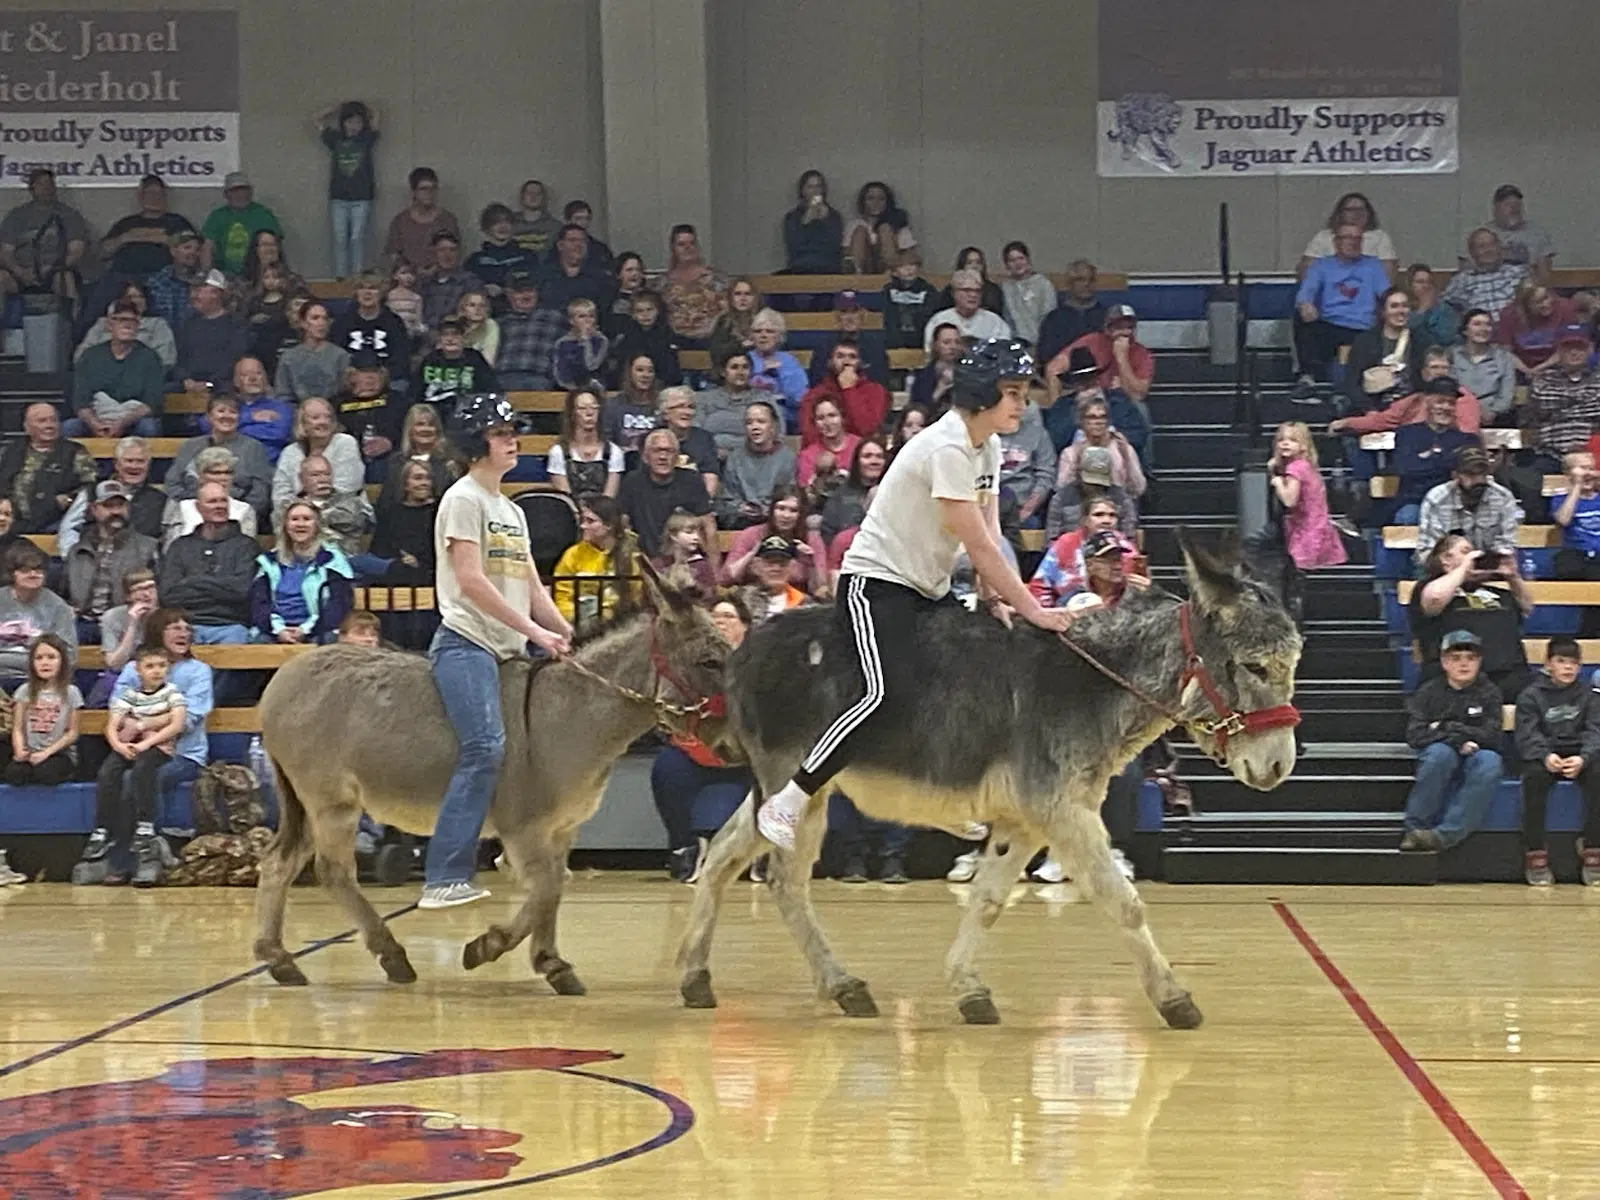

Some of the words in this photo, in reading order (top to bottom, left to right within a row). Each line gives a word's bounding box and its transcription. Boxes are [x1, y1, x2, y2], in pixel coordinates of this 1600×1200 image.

[26, 21, 67, 52] &
[72, 20, 181, 60] Janel
[0, 119, 95, 149] roudly
[100, 119, 227, 149] Supports
[1194, 105, 1308, 136] Proudly
[1314, 106, 1446, 136] Supports
[87, 153, 215, 176] Athletics
[1201, 141, 1297, 171] Jaguar
[1301, 140, 1433, 164] Athletics
